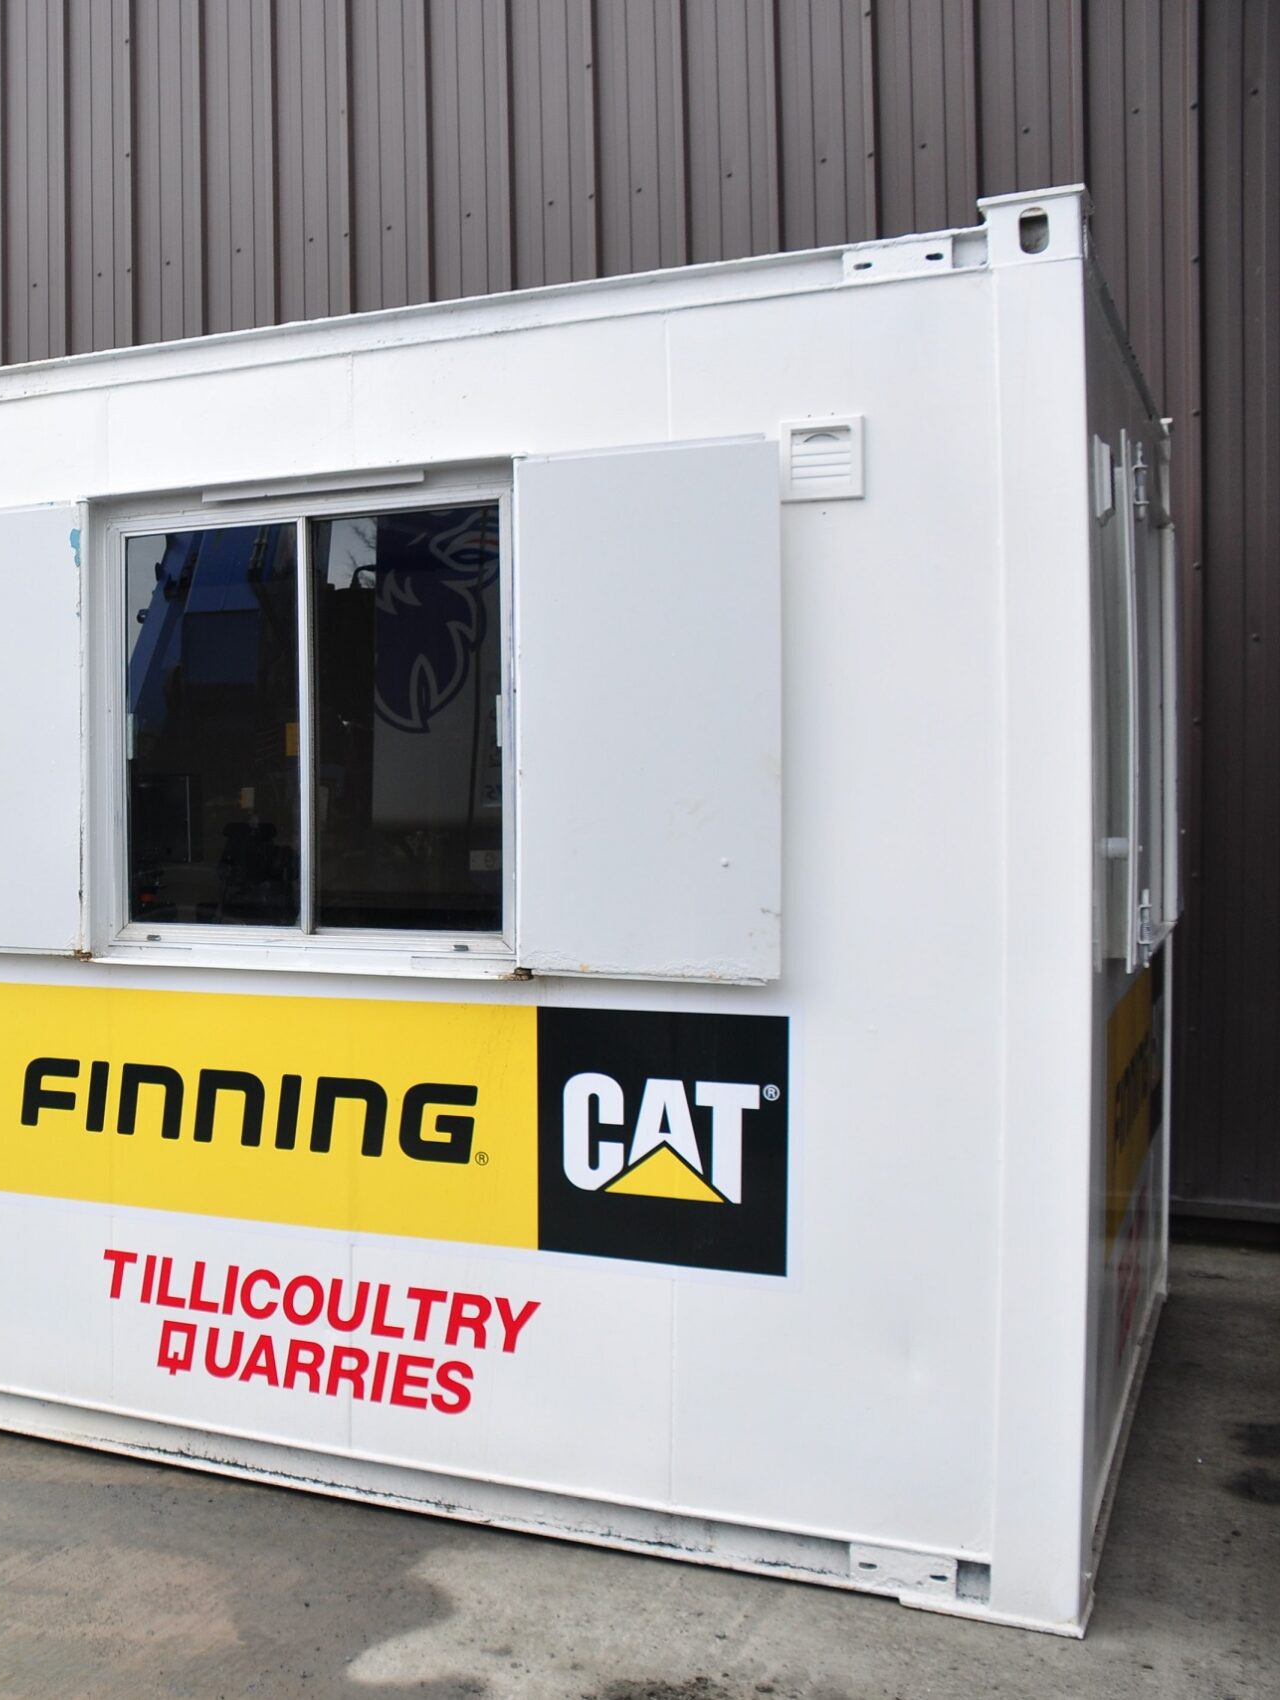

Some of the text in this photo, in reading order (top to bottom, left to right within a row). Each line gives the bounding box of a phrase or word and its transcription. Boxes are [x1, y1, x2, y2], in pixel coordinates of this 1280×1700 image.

[21, 1056, 479, 1165] FINNING
[562, 1072, 761, 1204] CAT
[103, 1249, 541, 1354] TILLICOULTRY
[157, 1320, 474, 1415] QUARRIES
